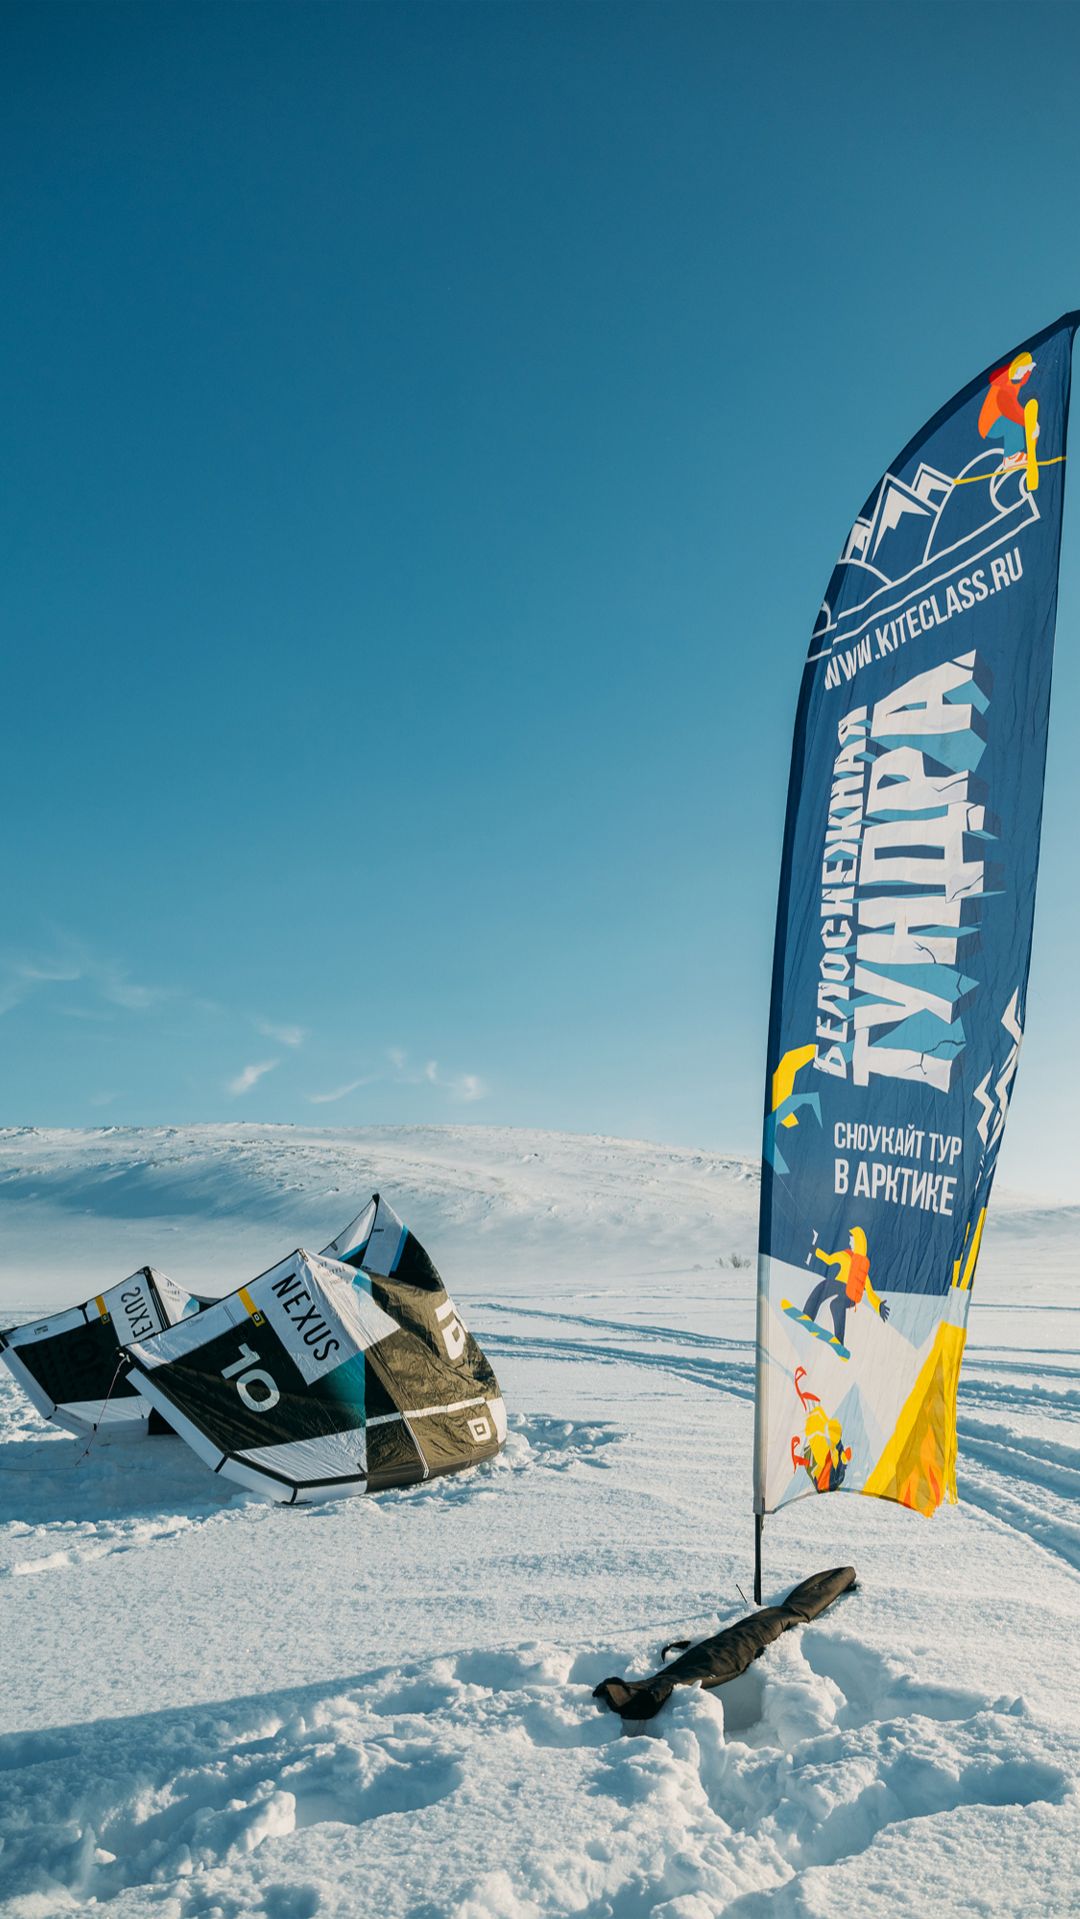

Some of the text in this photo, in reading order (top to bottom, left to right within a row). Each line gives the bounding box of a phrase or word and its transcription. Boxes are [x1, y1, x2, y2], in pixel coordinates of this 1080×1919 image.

[812, 704, 868, 1080] БЕЛОСНЕЖНАЯ
[852, 648, 986, 1095] ТУНДРА
[833, 1121, 963, 1166] СНОУКАЙТ ТУР
[833, 1158, 958, 1217] В АРКТИКЕ
[271, 1272, 340, 1361] NEXUS
[220, 1342, 281, 1413] 10
